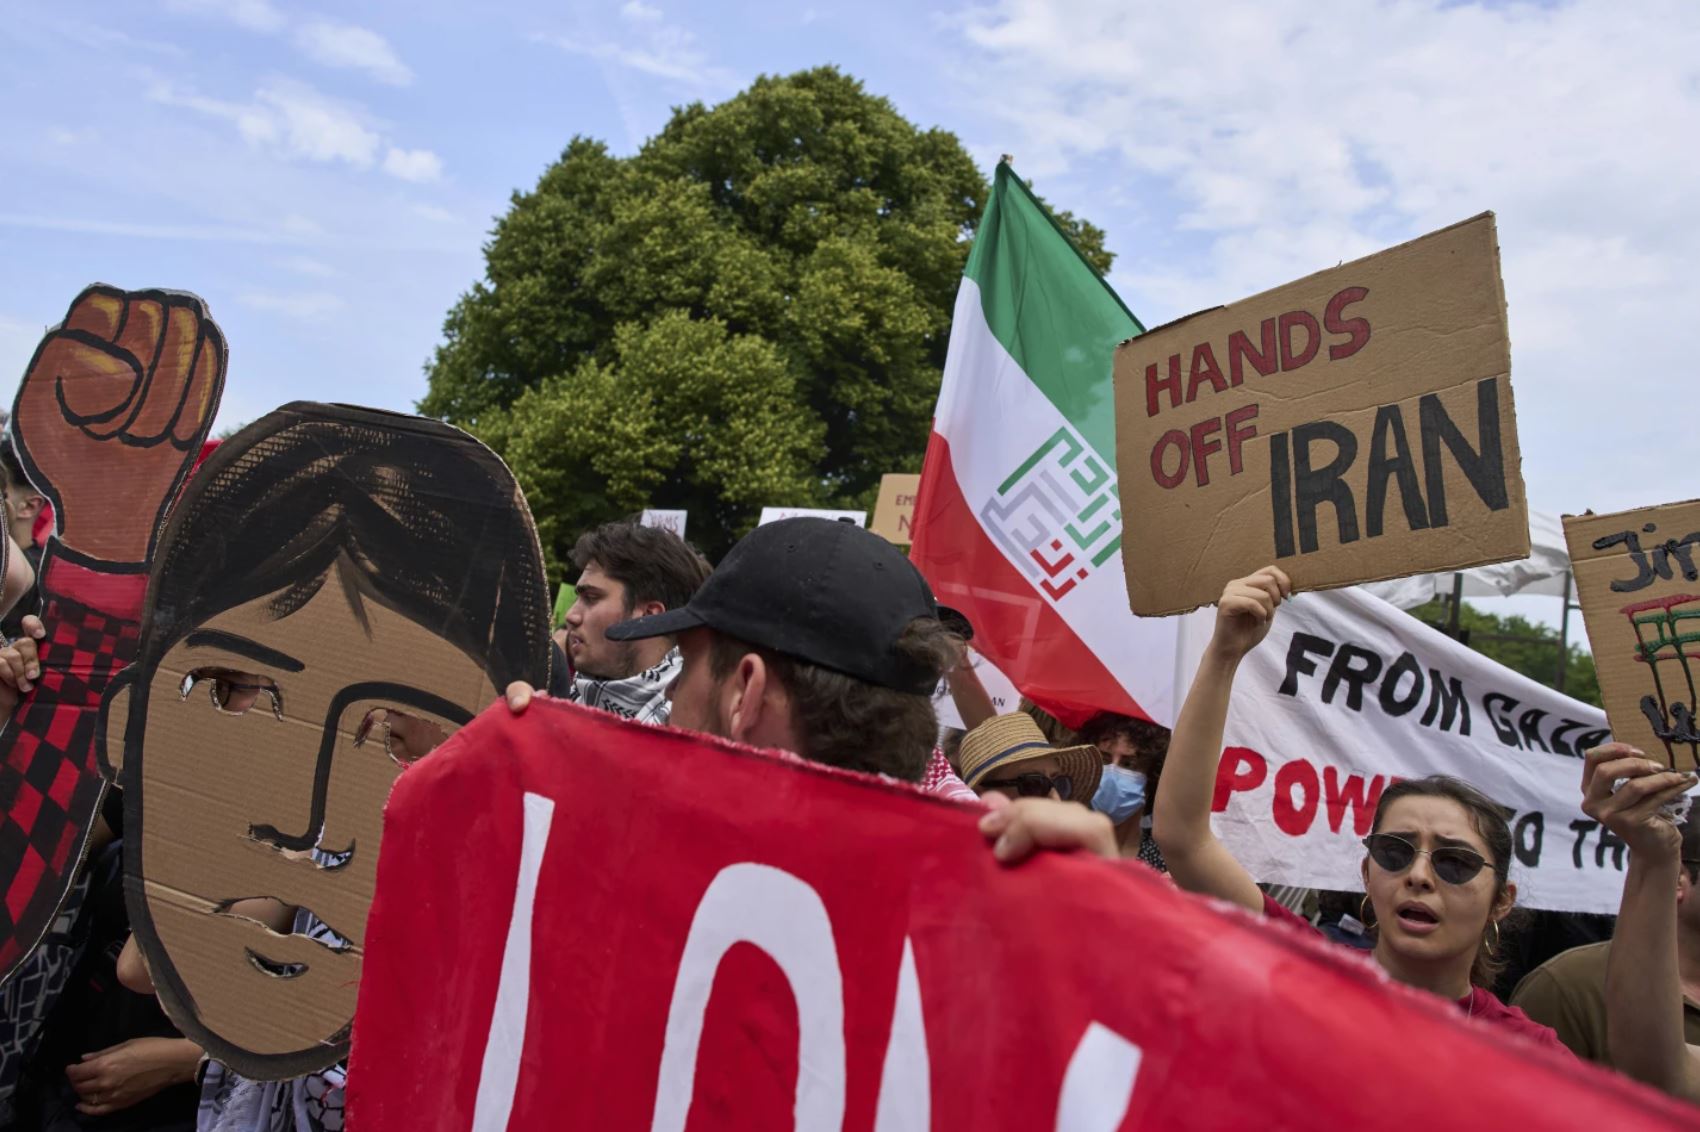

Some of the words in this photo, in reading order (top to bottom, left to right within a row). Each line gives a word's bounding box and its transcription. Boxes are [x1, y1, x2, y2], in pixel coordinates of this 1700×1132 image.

[1145, 286, 1372, 418] HANDS
[1150, 403, 1259, 489] OFF
[1270, 377, 1509, 559] IRAN
[1278, 631, 1473, 737] FROM
[1211, 746, 1408, 836] POW
[1569, 819, 1631, 872] TH
